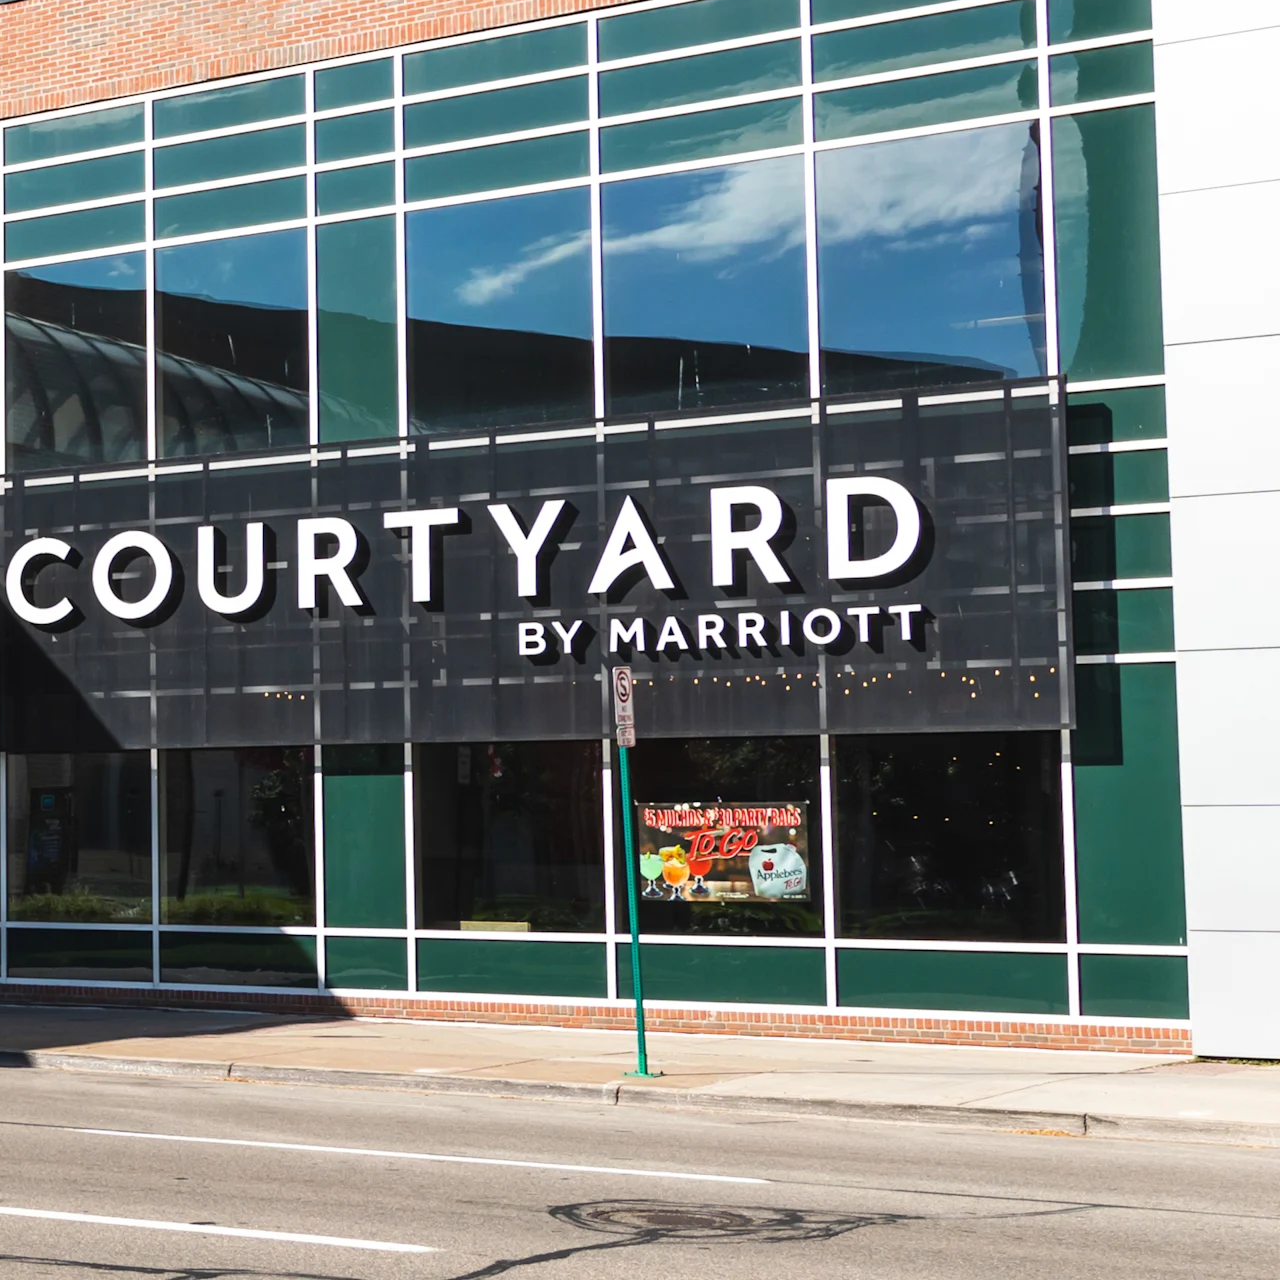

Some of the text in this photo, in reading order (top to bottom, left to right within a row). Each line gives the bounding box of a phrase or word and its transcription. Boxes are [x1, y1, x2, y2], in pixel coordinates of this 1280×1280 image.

[6, 476, 920, 625] COURTYARD
[519, 604, 922, 656] BY MARRIOTT
[644, 808, 656, 826] $5
[656, 808, 702, 826] MUCHOS
[735, 807, 769, 826] PARTY
[771, 807, 802, 826] BAGS
